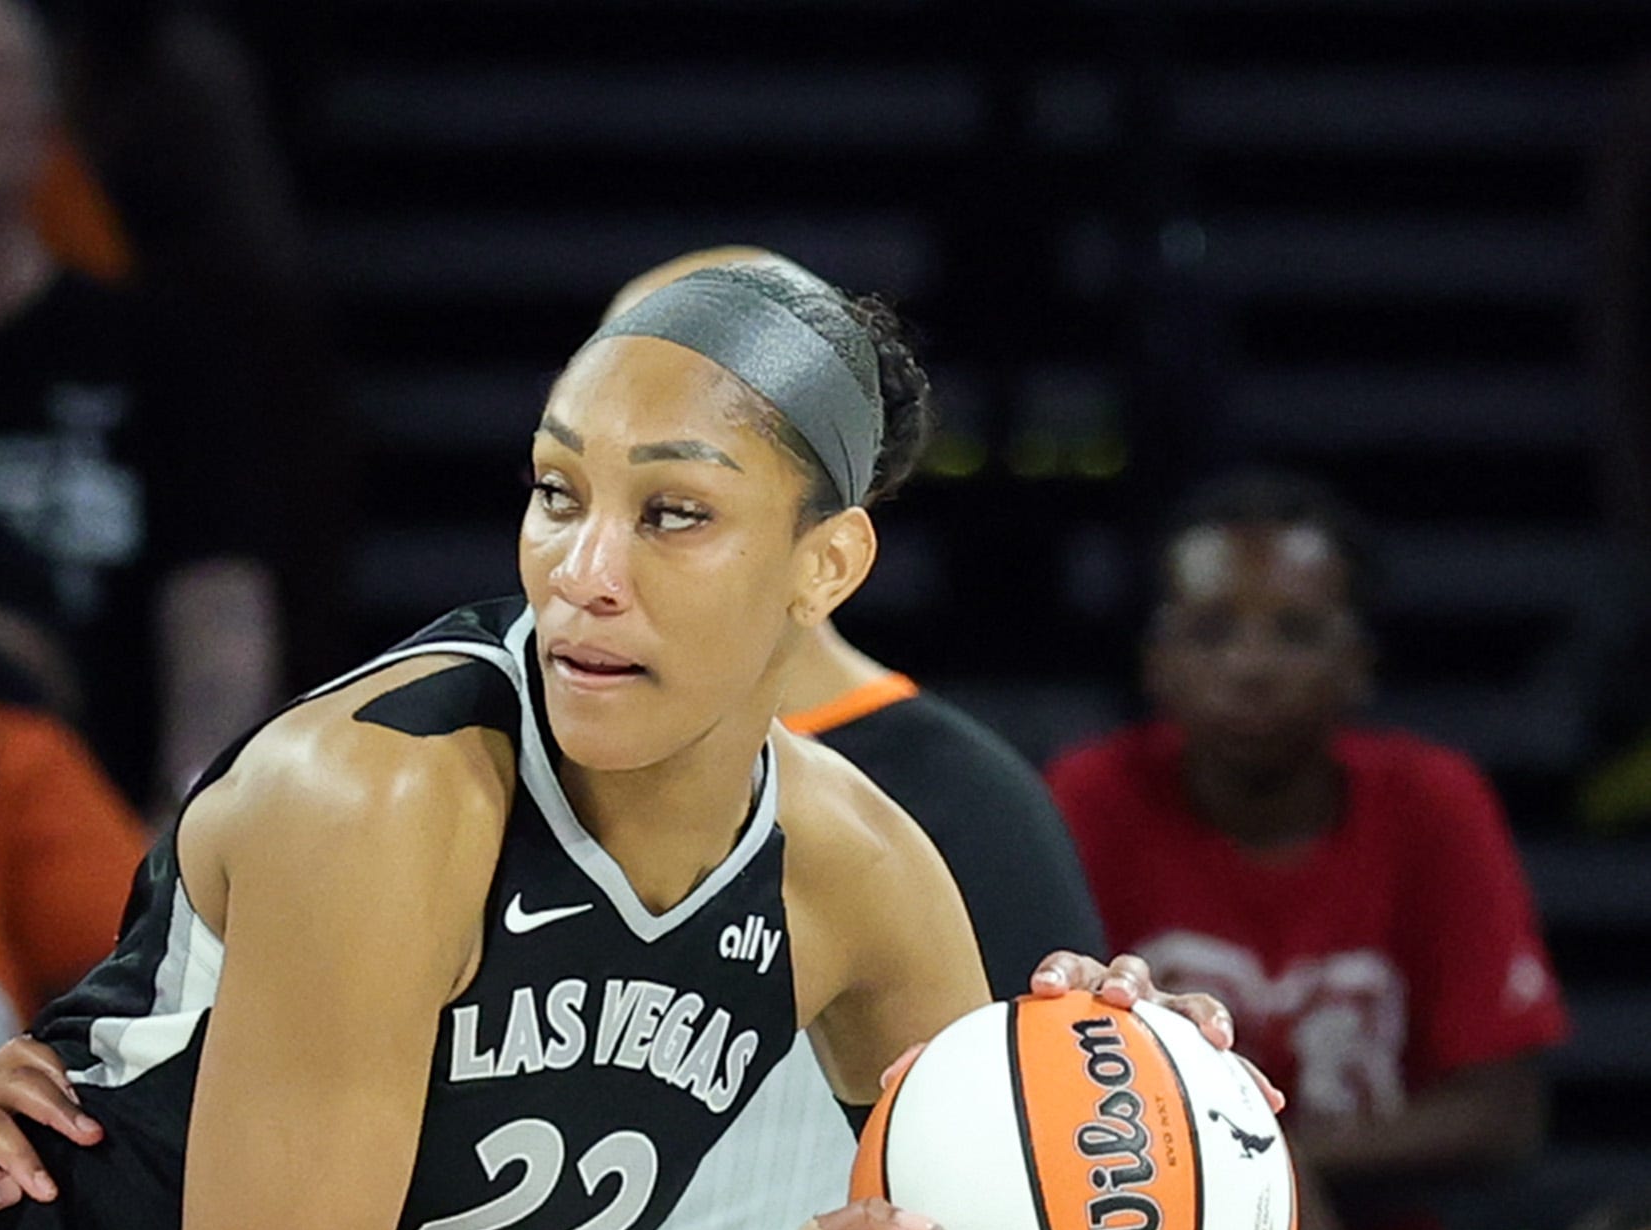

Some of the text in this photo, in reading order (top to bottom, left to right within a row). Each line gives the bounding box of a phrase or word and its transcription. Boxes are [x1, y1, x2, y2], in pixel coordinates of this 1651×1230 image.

[719, 914, 782, 975] ally
[449, 978, 759, 1114] LAS VEGAS
